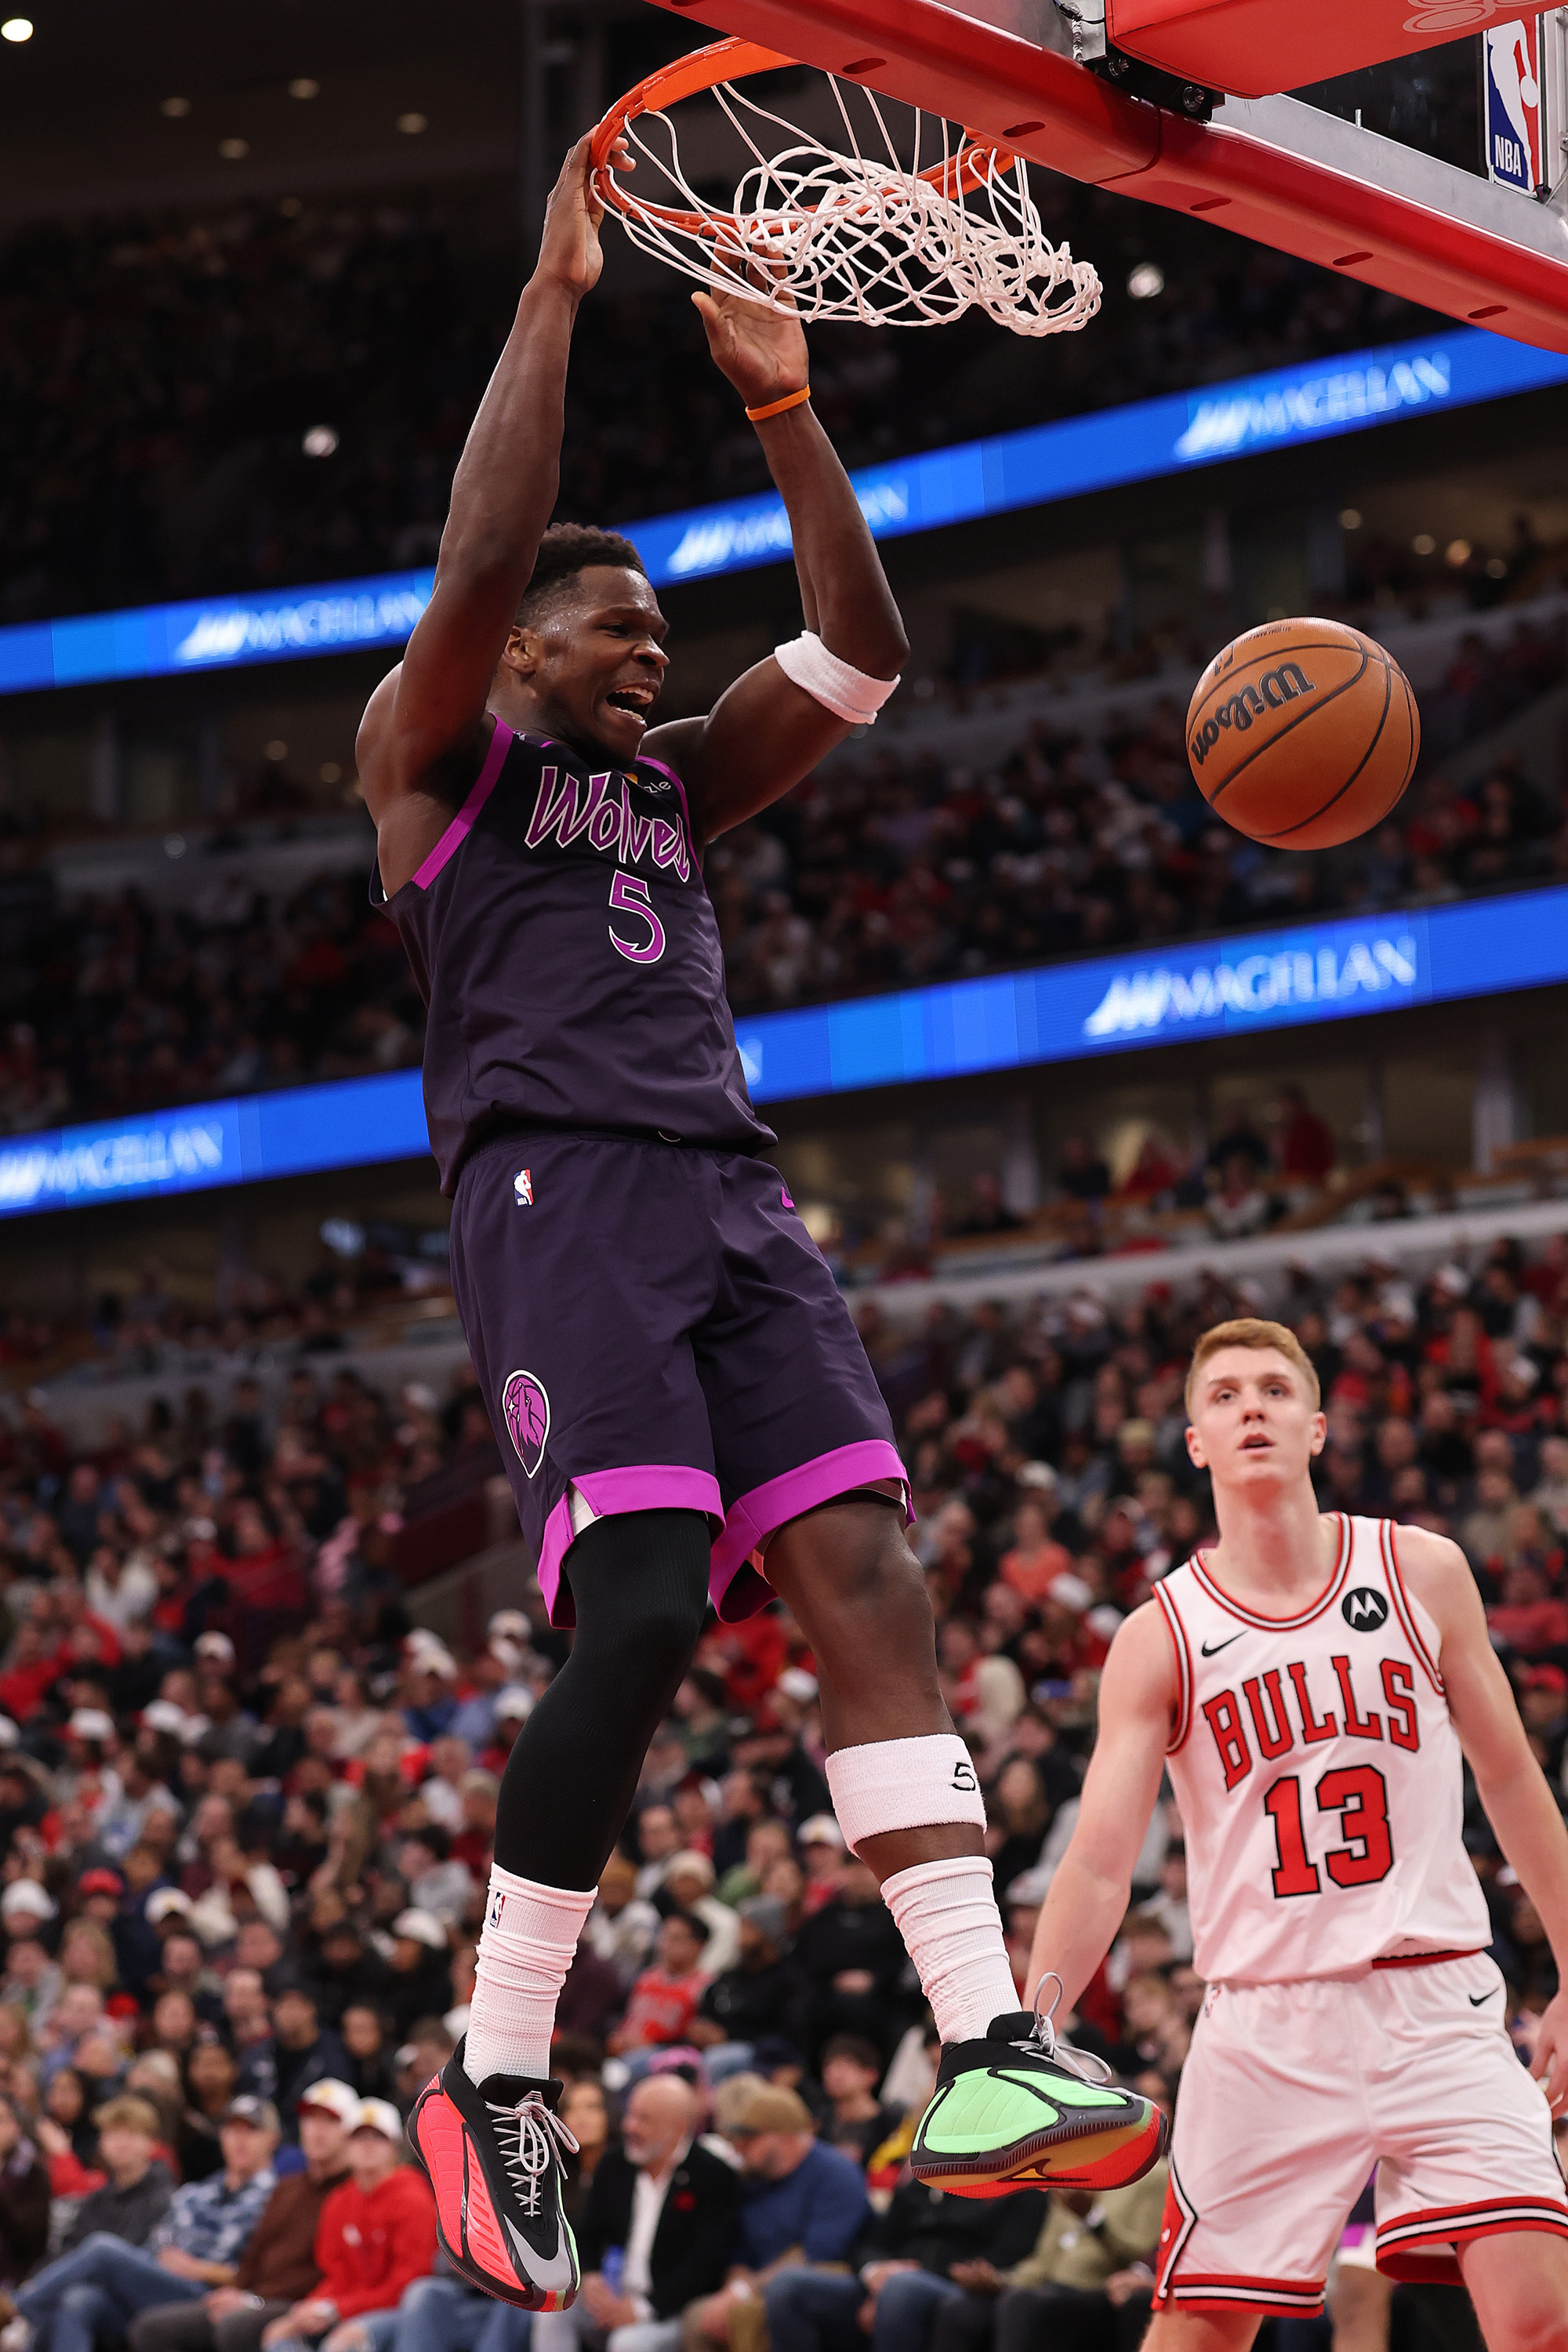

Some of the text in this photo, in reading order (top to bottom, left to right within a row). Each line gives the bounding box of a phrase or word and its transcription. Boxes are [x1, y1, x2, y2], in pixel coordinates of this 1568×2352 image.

[1494, 133, 1523, 178] NBA
[1190, 662, 1316, 766] Wilson
[524, 765, 691, 883] Wolves
[644, 781, 672, 793] zle
[608, 869, 666, 964] 5
[1201, 1655, 1421, 1792] BULLS
[951, 1762, 976, 1791] 5
[1264, 1764, 1394, 1899] 13
